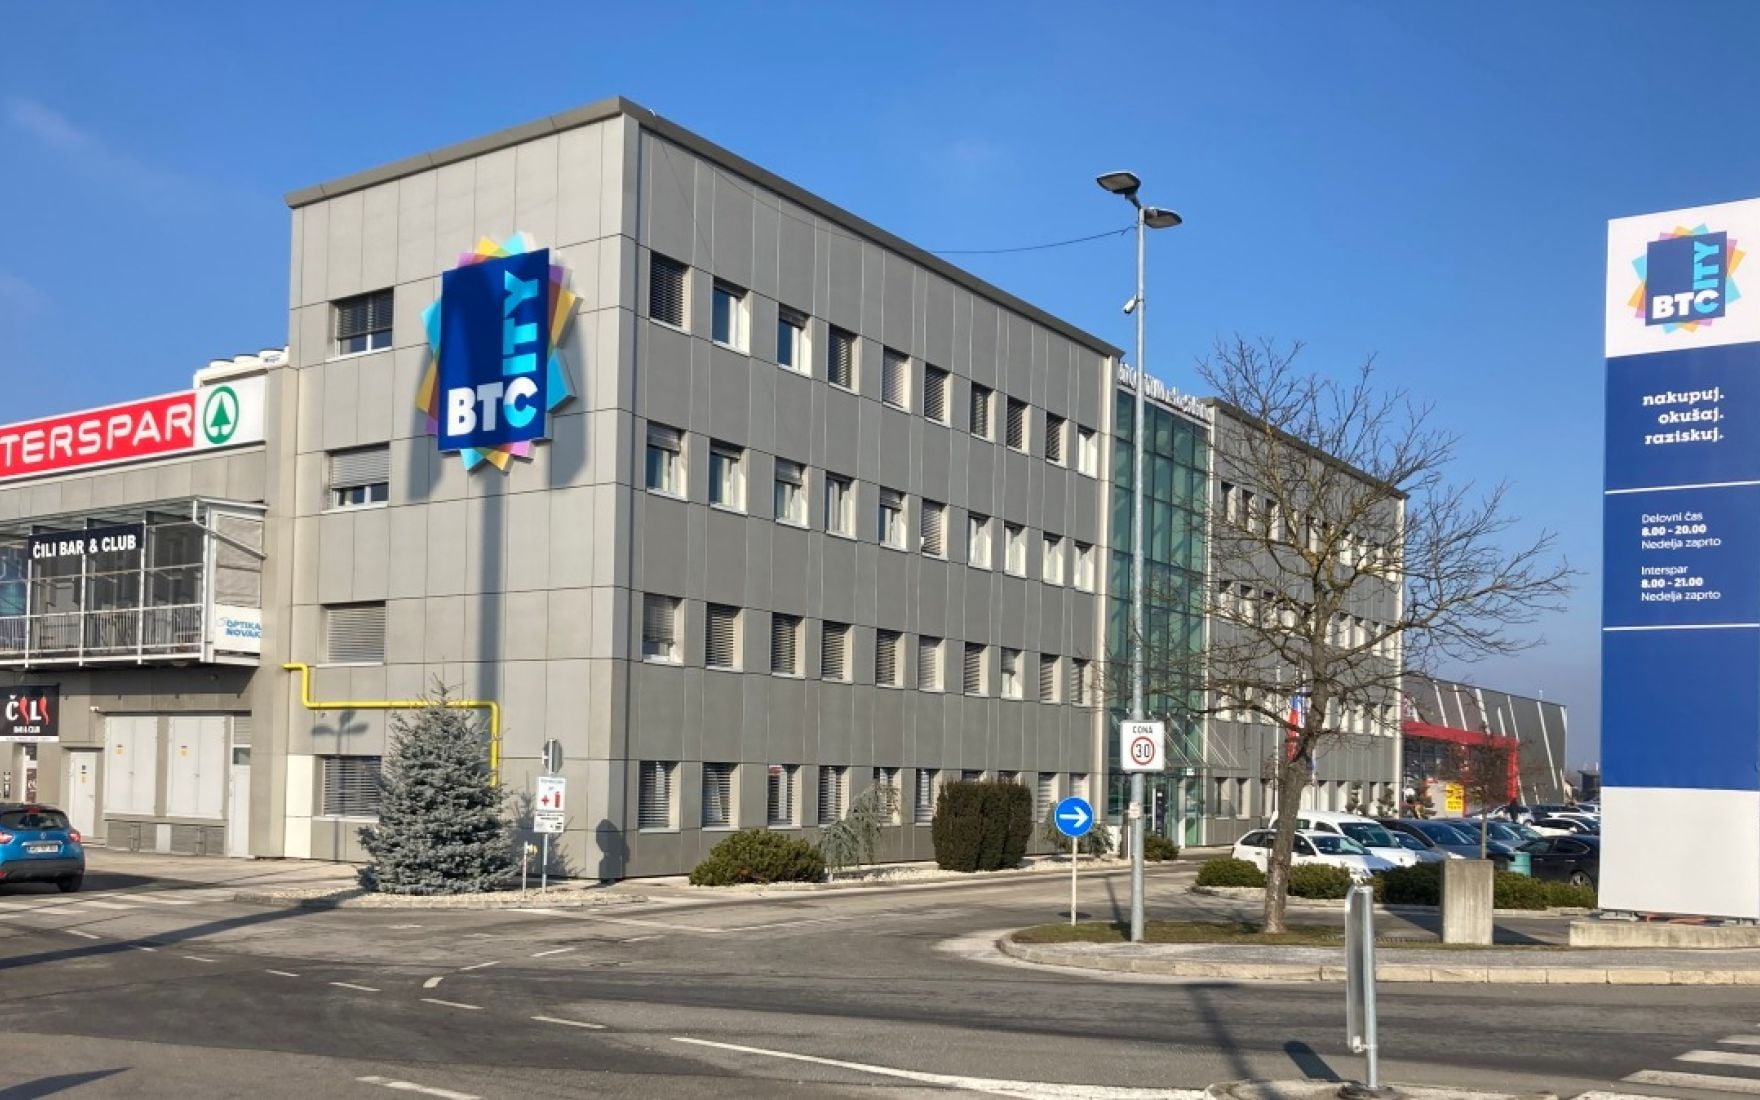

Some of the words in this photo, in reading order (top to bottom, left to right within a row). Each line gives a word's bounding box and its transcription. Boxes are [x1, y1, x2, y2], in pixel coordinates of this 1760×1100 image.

[1652, 289, 1719, 319] BTC
[1642, 387, 1725, 406] nakupuj.
[447, 377, 538, 436] BTC
[1658, 407, 1724, 424] okušaj.
[1644, 427, 1724, 445] raziskuj.
[1642, 513, 1682, 524] Delovni
[1684, 511, 1703, 521] čas
[1641, 527, 1666, 536] 8.00
[1675, 524, 1707, 534] 20.00
[33, 541, 57, 559] ČILI
[59, 540, 84, 555] BAR
[89, 538, 98, 553] &
[102, 534, 136, 552] CLUB
[1642, 539, 1683, 550] Nedelja
[1685, 537, 1722, 548] zaprto
[1641, 565, 1688, 576] Interspar
[1641, 579, 1665, 588] 8.00
[1674, 577, 1704, 587] 21.00
[1642, 592, 1682, 602] Nedelja
[1685, 590, 1721, 601] zaprto
[1135, 743, 1150, 758] 30
